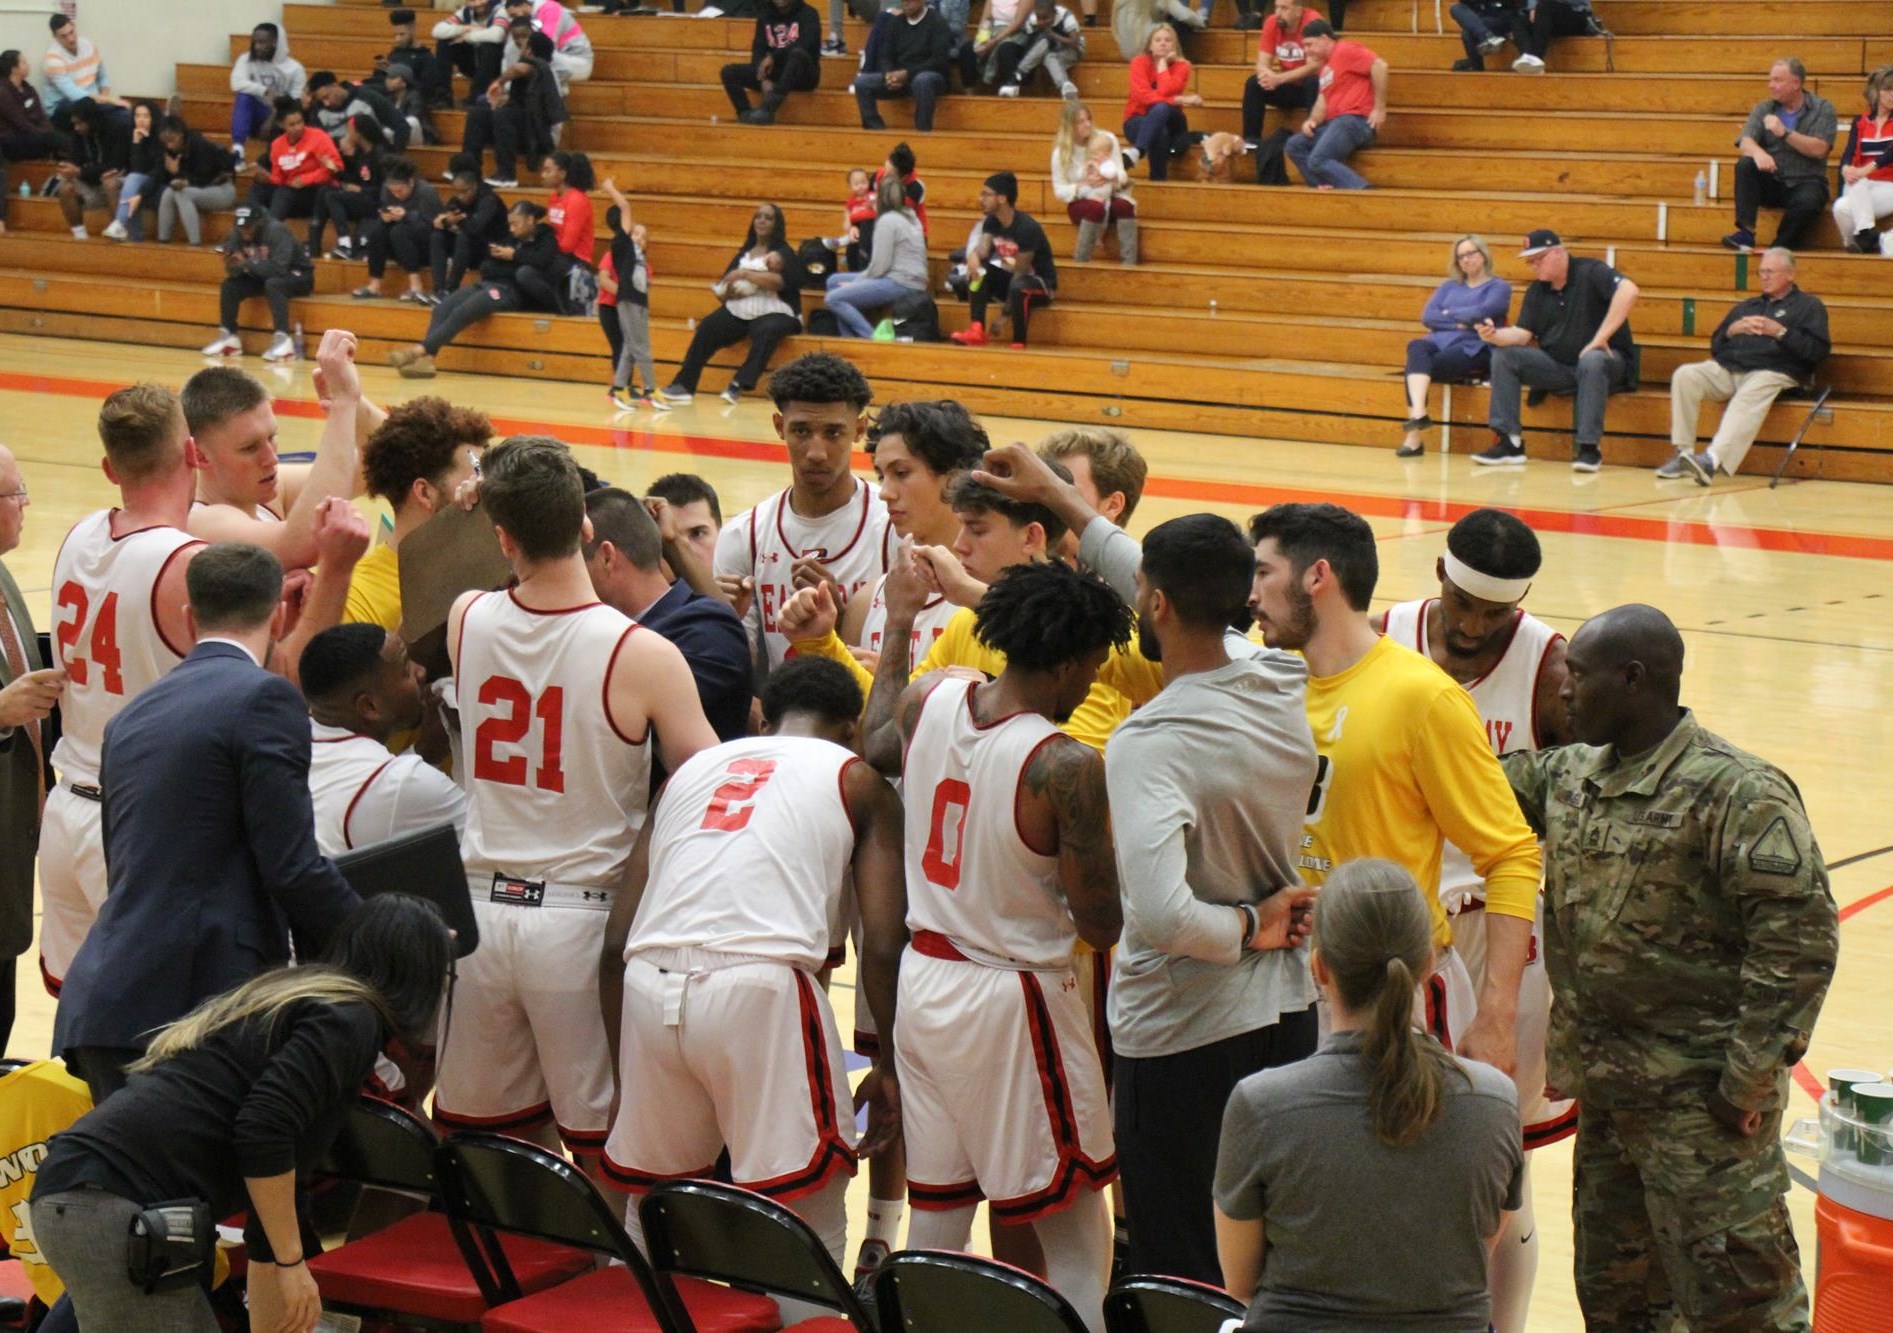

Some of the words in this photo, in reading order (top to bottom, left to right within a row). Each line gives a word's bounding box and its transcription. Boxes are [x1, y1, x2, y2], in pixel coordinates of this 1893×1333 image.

[57, 580, 125, 696] 24
[474, 675, 565, 793] 21
[701, 759, 775, 832] 2
[921, 777, 971, 890] 0
